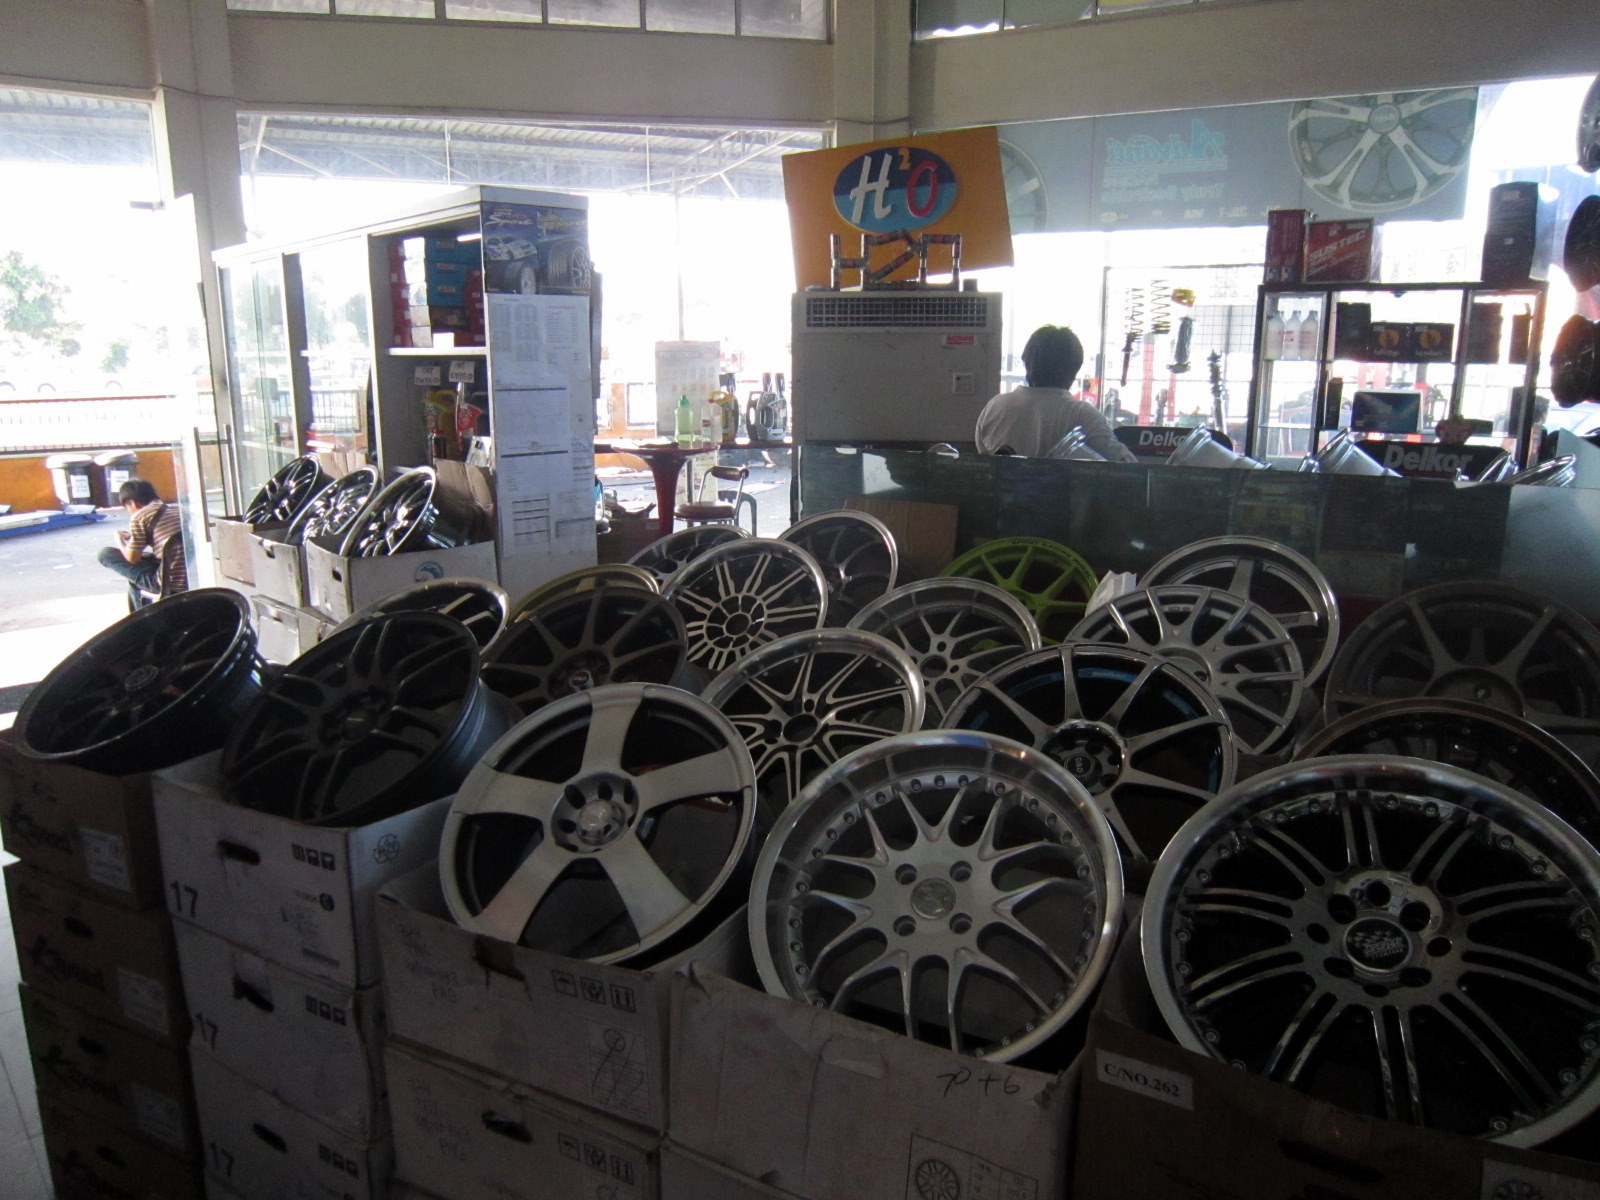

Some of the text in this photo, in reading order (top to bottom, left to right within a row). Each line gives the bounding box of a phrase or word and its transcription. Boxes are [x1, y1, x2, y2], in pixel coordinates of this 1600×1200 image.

[1383, 444, 1473, 473] Delkor
[170, 880, 198, 918] 17
[1104, 1063, 1179, 1097] C/NO.262
